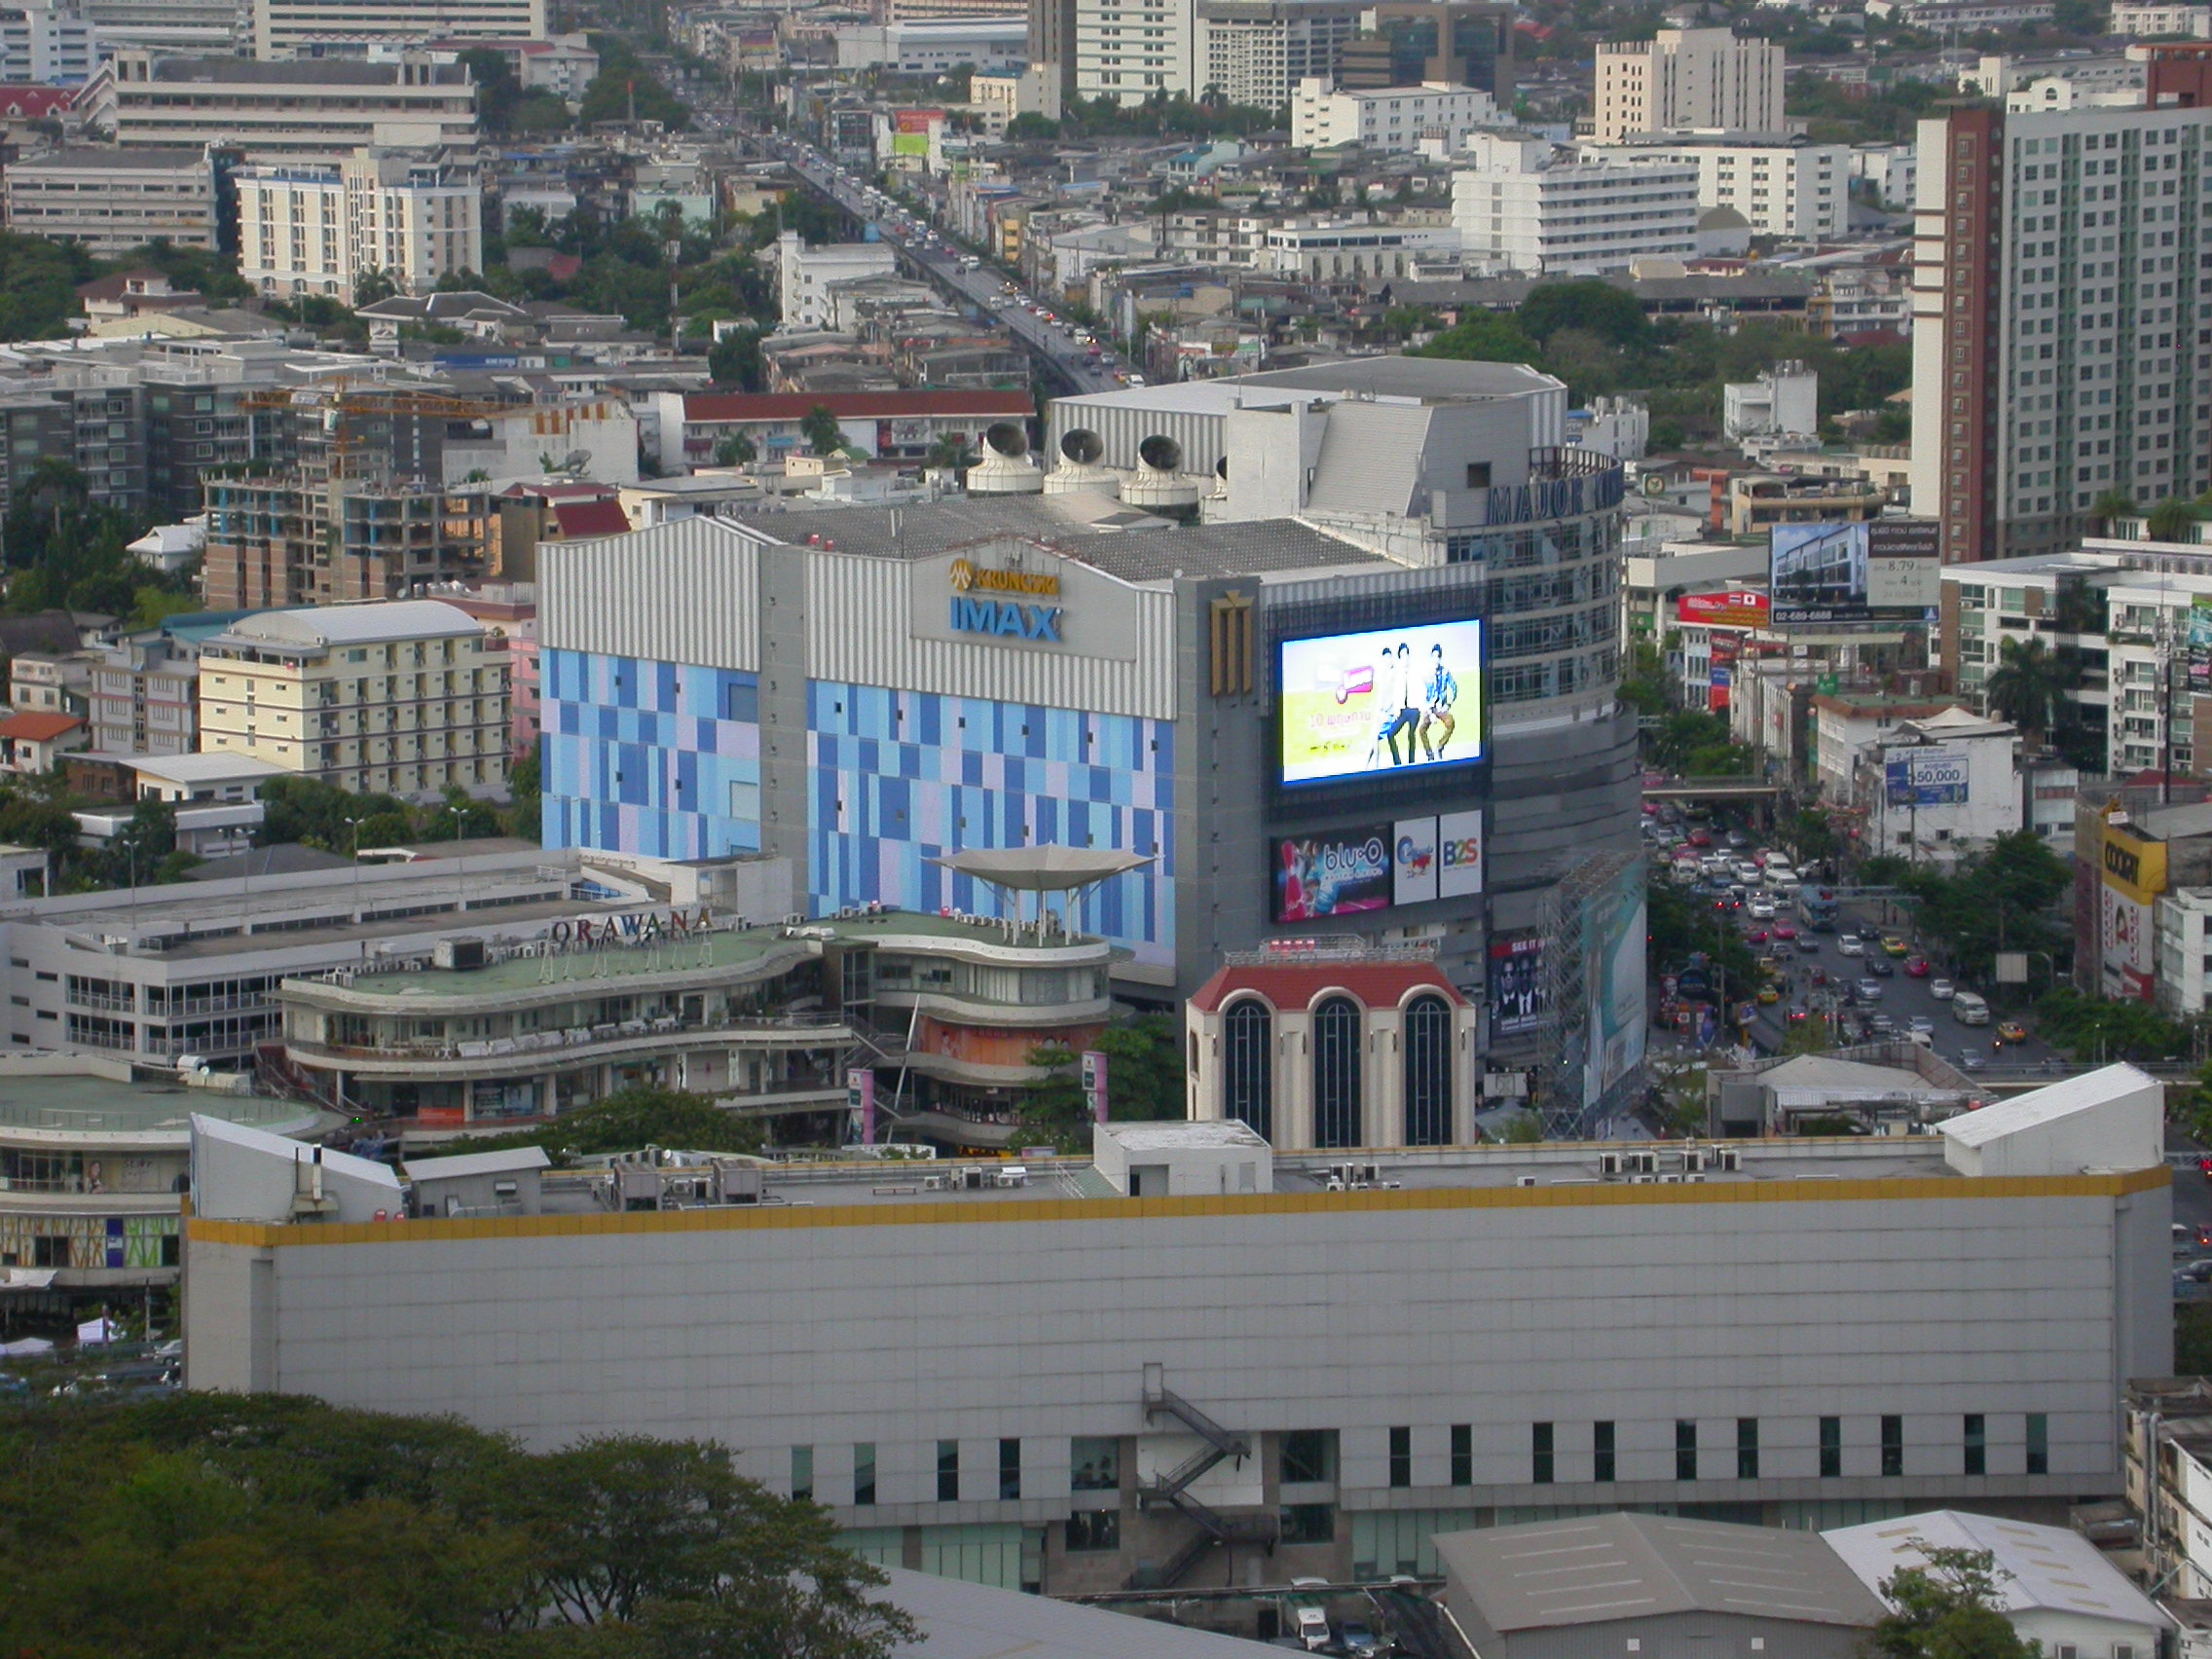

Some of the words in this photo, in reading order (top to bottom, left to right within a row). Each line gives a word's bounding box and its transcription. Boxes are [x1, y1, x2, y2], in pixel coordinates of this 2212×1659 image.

[1487, 478, 1583, 526] MAJOR
[950, 596, 1060, 642] IMAX
[1776, 610, 1832, 621] 02-689-6888
[1917, 769, 1960, 784] 50,000
[1443, 838, 1478, 866] B2S
[553, 907, 713, 946] ORAWANA
[1512, 941, 1528, 952] SEE
[1530, 940, 1536, 950] IT
